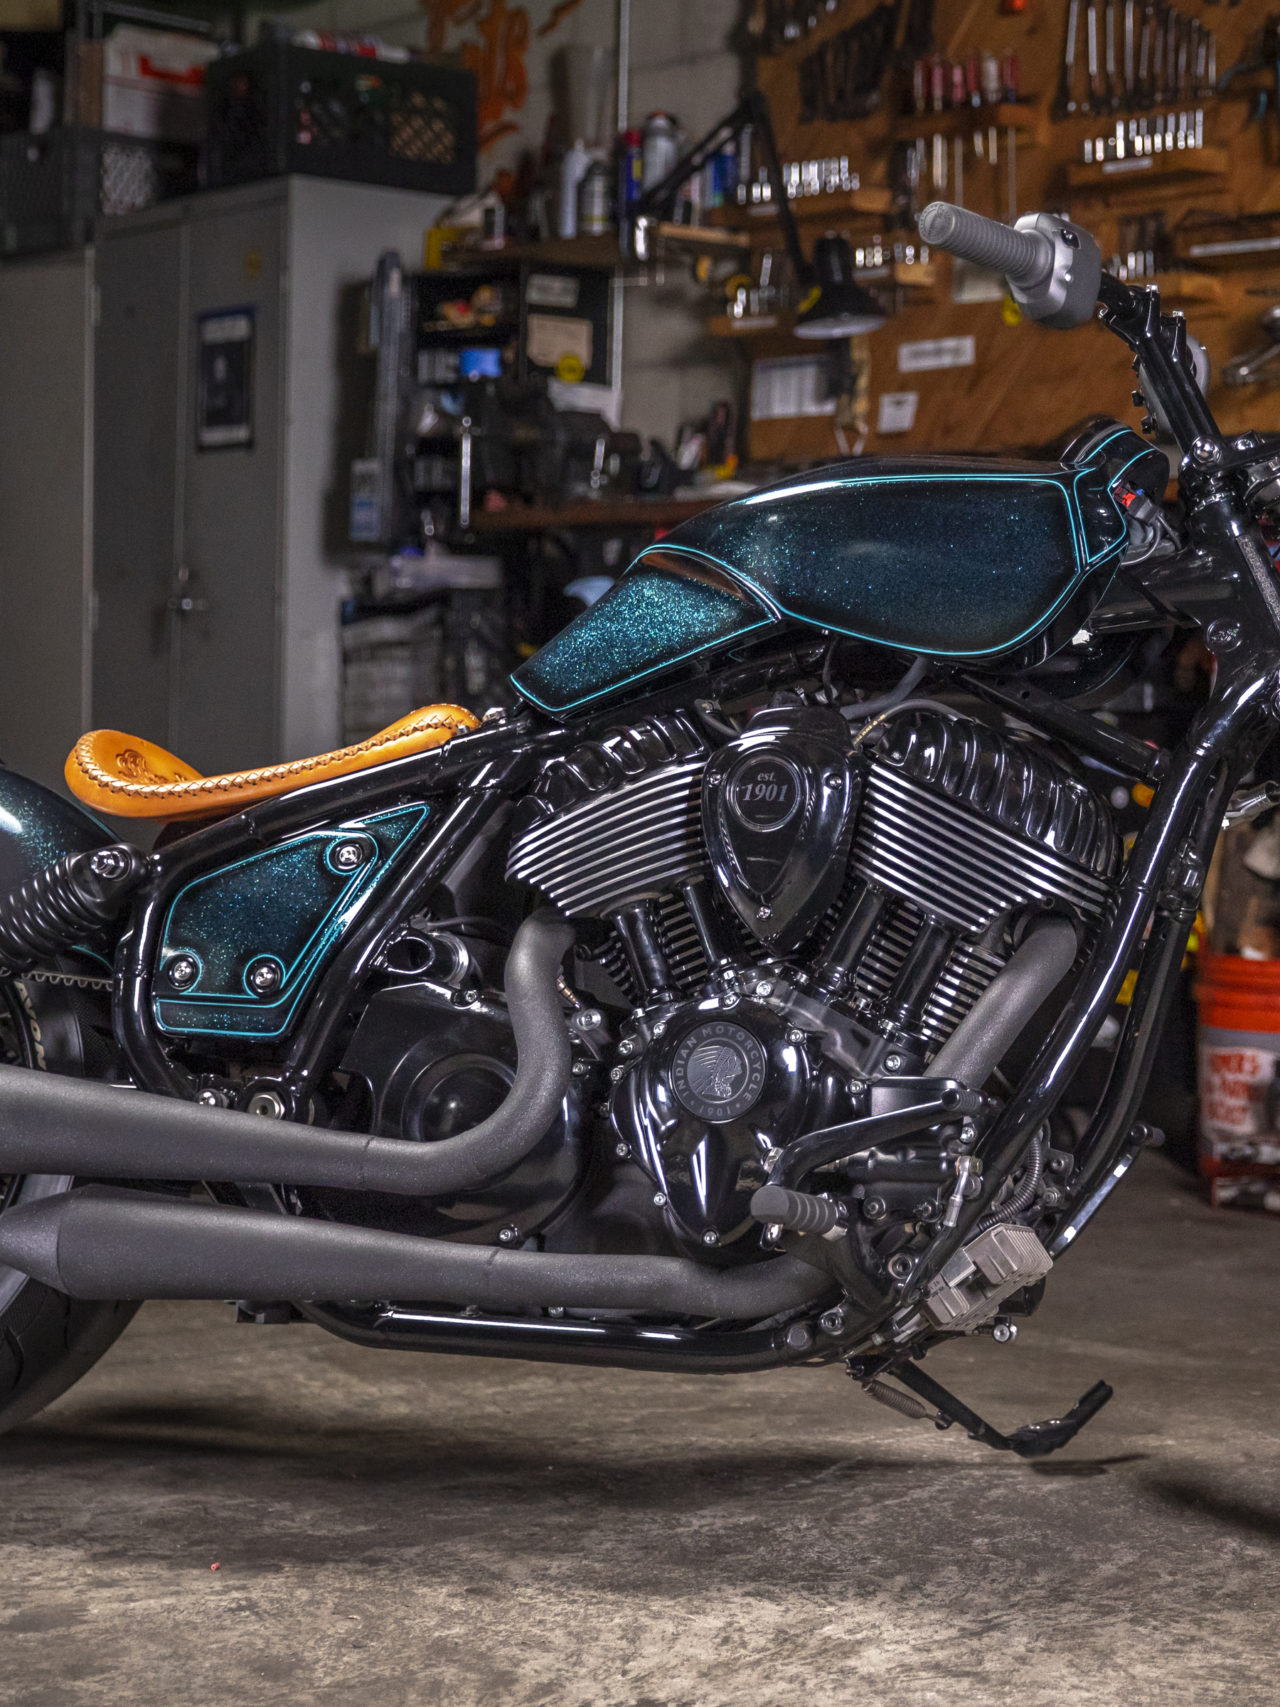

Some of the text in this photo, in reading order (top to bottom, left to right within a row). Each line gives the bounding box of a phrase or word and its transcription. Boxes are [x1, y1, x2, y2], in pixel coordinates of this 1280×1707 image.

[742, 783, 788, 802] 1901
[757, 772, 777, 782] est.
[14, 980, 48, 1071] AVON
[675, 1025, 762, 1101] INDIAN MOTORCYCLE
